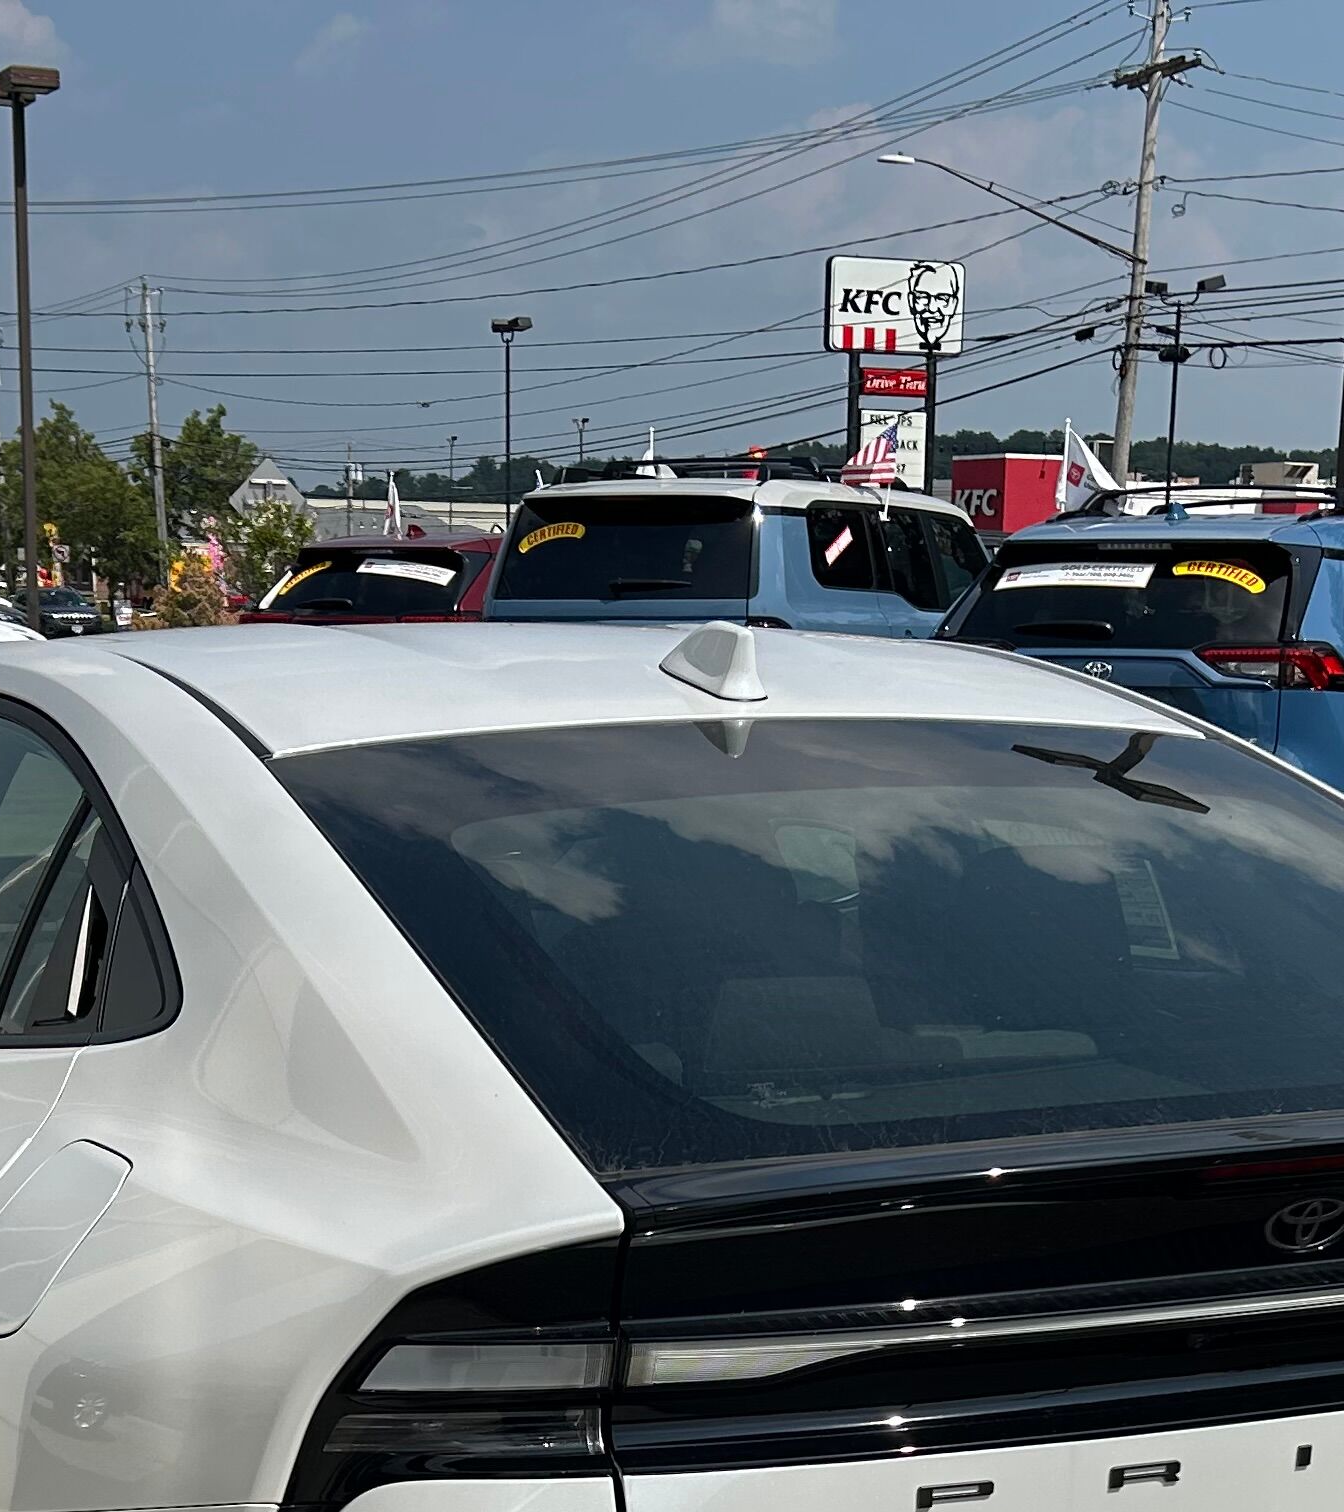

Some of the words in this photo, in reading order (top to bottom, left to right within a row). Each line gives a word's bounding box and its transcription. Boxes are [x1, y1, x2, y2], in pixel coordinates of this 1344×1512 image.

[838, 288, 903, 316] KFC
[865, 374, 897, 389] Drive
[899, 376, 927, 390] Thru
[955, 489, 997, 516] KFC
[527, 524, 579, 545] CERTIFIED
[1187, 561, 1258, 586] CERTIFIED
